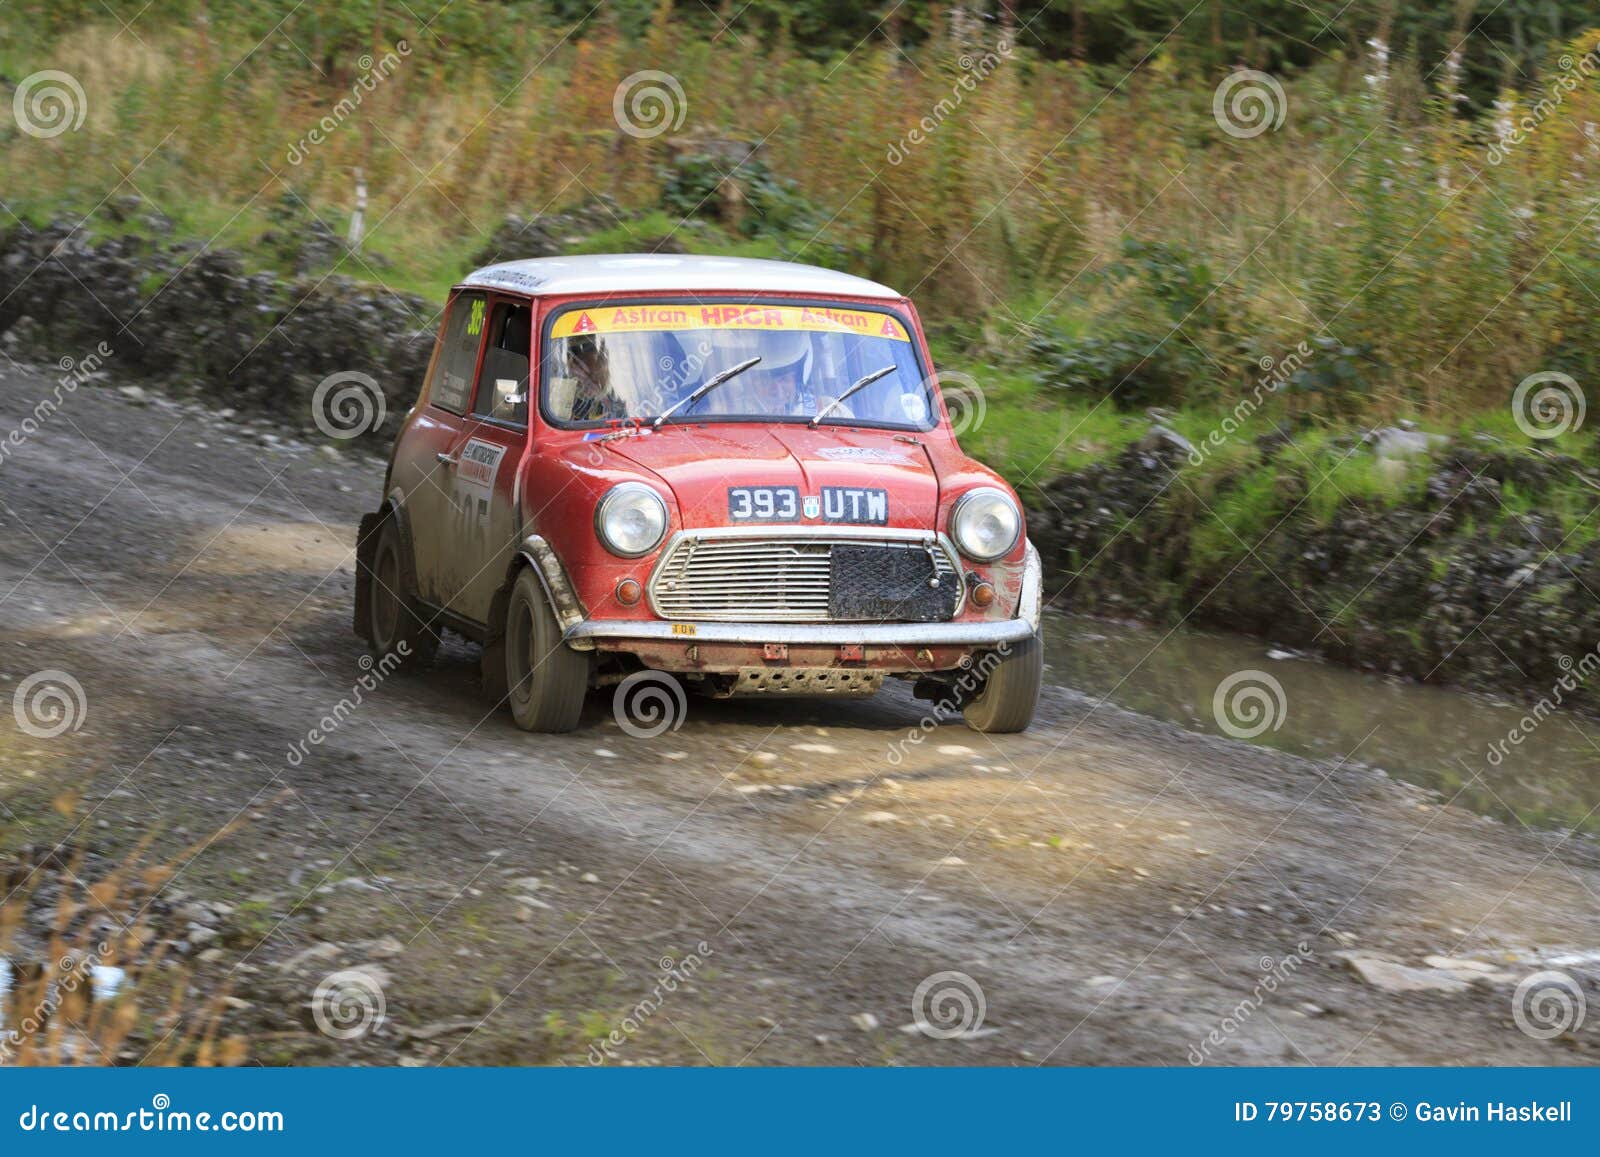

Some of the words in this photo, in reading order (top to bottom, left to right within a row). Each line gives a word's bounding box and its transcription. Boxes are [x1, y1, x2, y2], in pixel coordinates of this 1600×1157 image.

[612, 308, 687, 325] Astran
[701, 306, 784, 327] HRCR
[801, 307, 869, 328] Astran
[730, 488, 797, 518] 393
[823, 489, 887, 521] UTW
